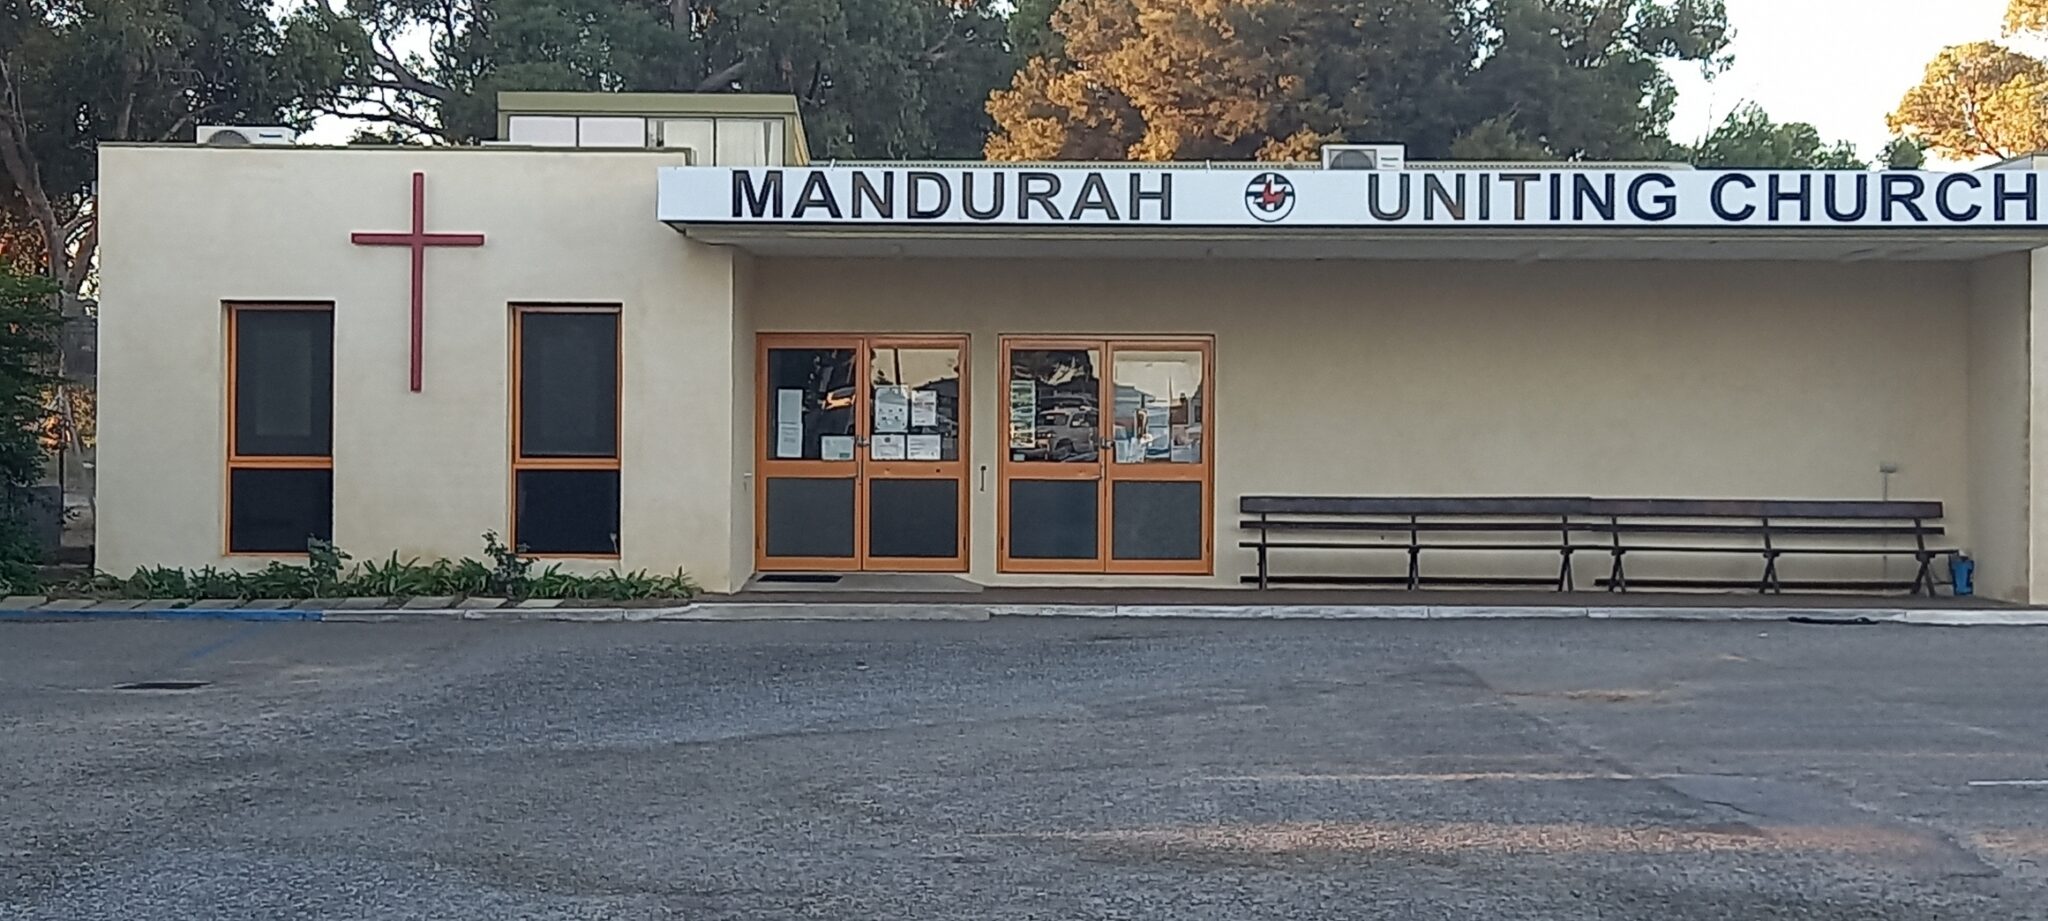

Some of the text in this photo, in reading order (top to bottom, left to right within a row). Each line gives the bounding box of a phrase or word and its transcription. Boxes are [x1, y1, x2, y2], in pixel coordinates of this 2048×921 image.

[731, 169, 2038, 222] MANDURAH UNITING CHURCH
